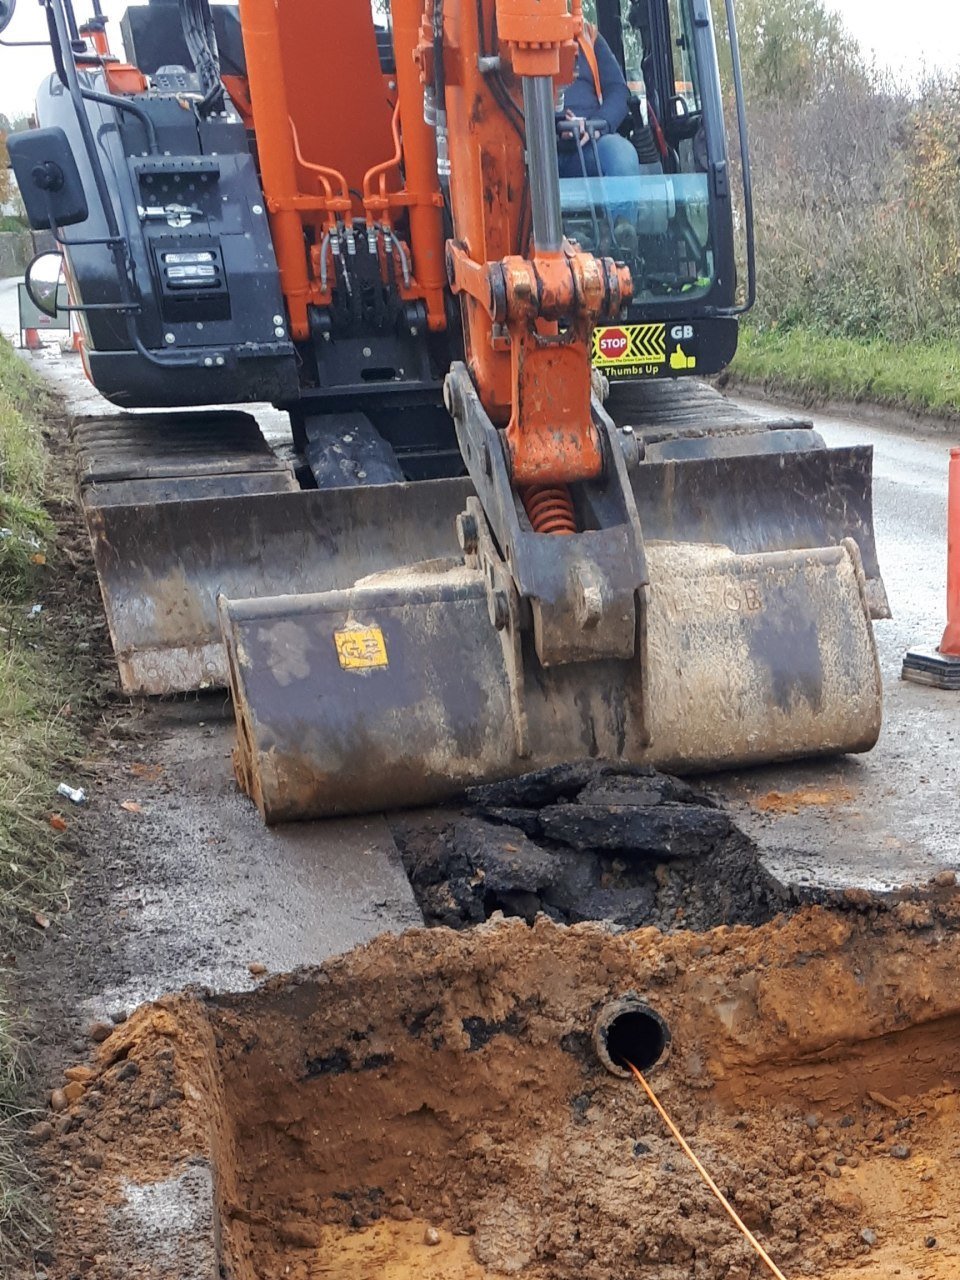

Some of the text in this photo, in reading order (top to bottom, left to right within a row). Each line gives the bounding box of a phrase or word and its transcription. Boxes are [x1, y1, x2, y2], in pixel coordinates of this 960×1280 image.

[670, 325, 693, 339] GB
[601, 339, 627, 349] STOP
[605, 365, 659, 376] Thumbs Up
